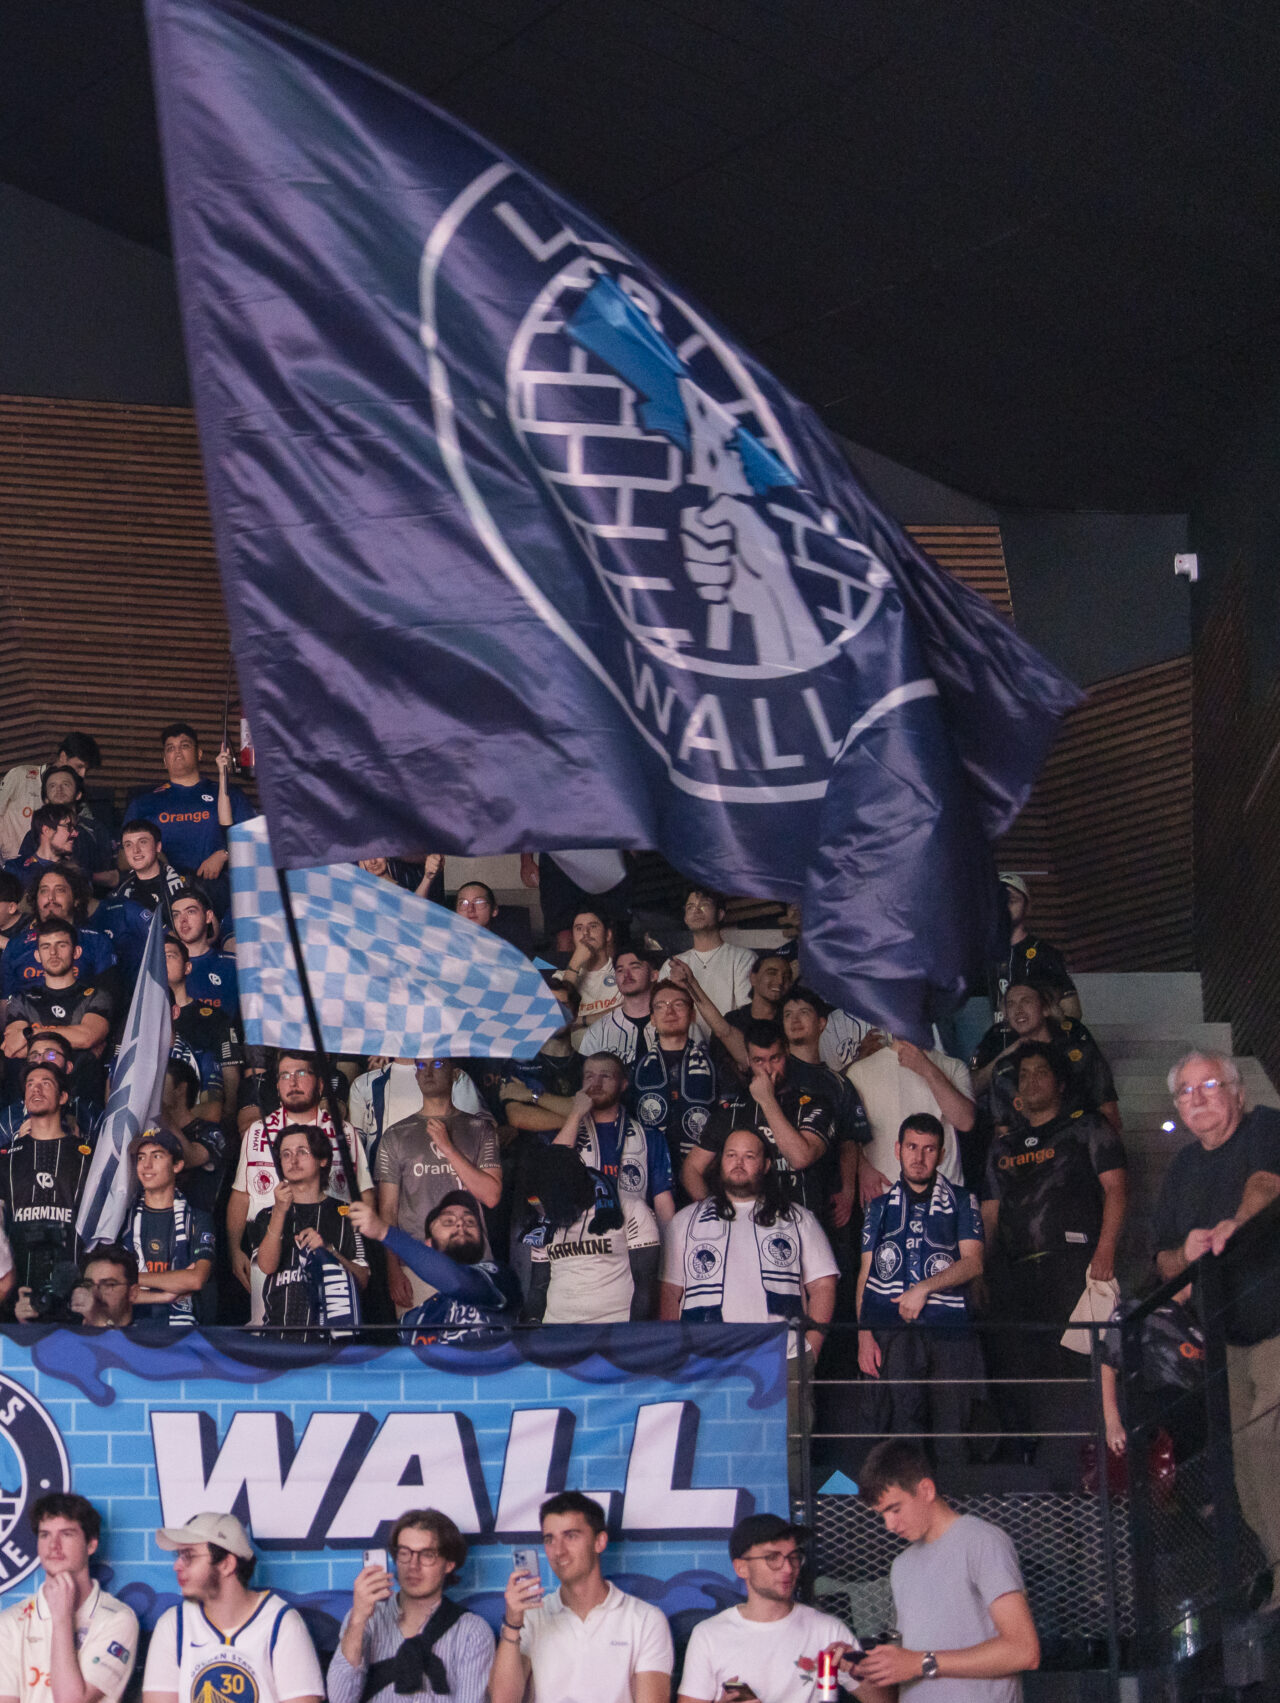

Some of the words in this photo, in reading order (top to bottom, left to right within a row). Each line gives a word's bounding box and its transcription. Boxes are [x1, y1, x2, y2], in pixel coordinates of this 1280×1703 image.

[624, 640, 845, 772] WALL
[159, 810, 210, 824] Orange
[580, 996, 618, 1011] range
[252, 1129, 261, 1152] WHAT
[414, 1163, 457, 1177] Orang
[998, 1148, 1055, 1170] Orange
[14, 1206, 73, 1223] KARMINE
[546, 1238, 613, 1261] KARMINE
[148, 1400, 757, 1550] WALL
[220, 1673, 245, 1695] 30
